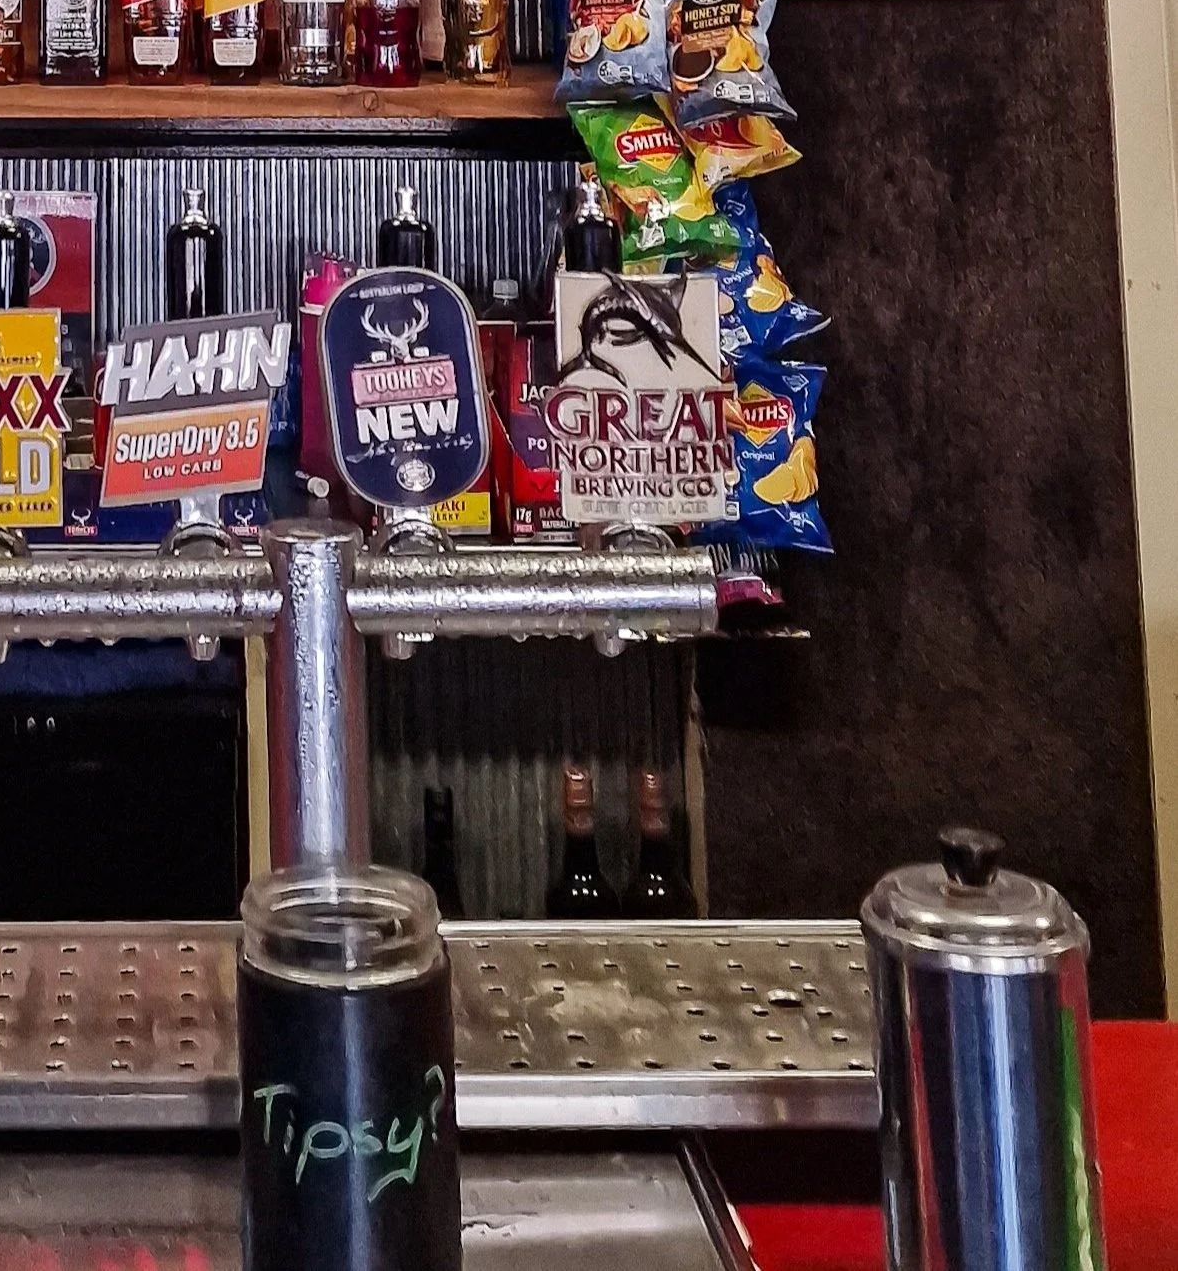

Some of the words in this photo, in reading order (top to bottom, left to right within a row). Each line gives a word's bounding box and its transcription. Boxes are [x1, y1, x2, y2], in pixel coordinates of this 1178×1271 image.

[685, 6, 720, 22] HONEY
[720, 3, 740, 15] SOY
[621, 130, 681, 154] SMITH
[101, 322, 292, 407] HAHN
[363, 366, 446, 393] TOOHEYS
[519, 383, 546, 402] JAC
[356, 398, 459, 444] NEW
[544, 388, 736, 445] GREAT
[115, 425, 223, 464] SuperDry
[225, 419, 260, 451] 3.5
[551, 441, 734, 475] NORTHERN
[742, 451, 775, 461] Original
[143, 462, 176, 480] LOW
[180, 460, 223, 476] CARB
[573, 478, 673, 498] BREWING
[516, 508, 532, 523] 17g
